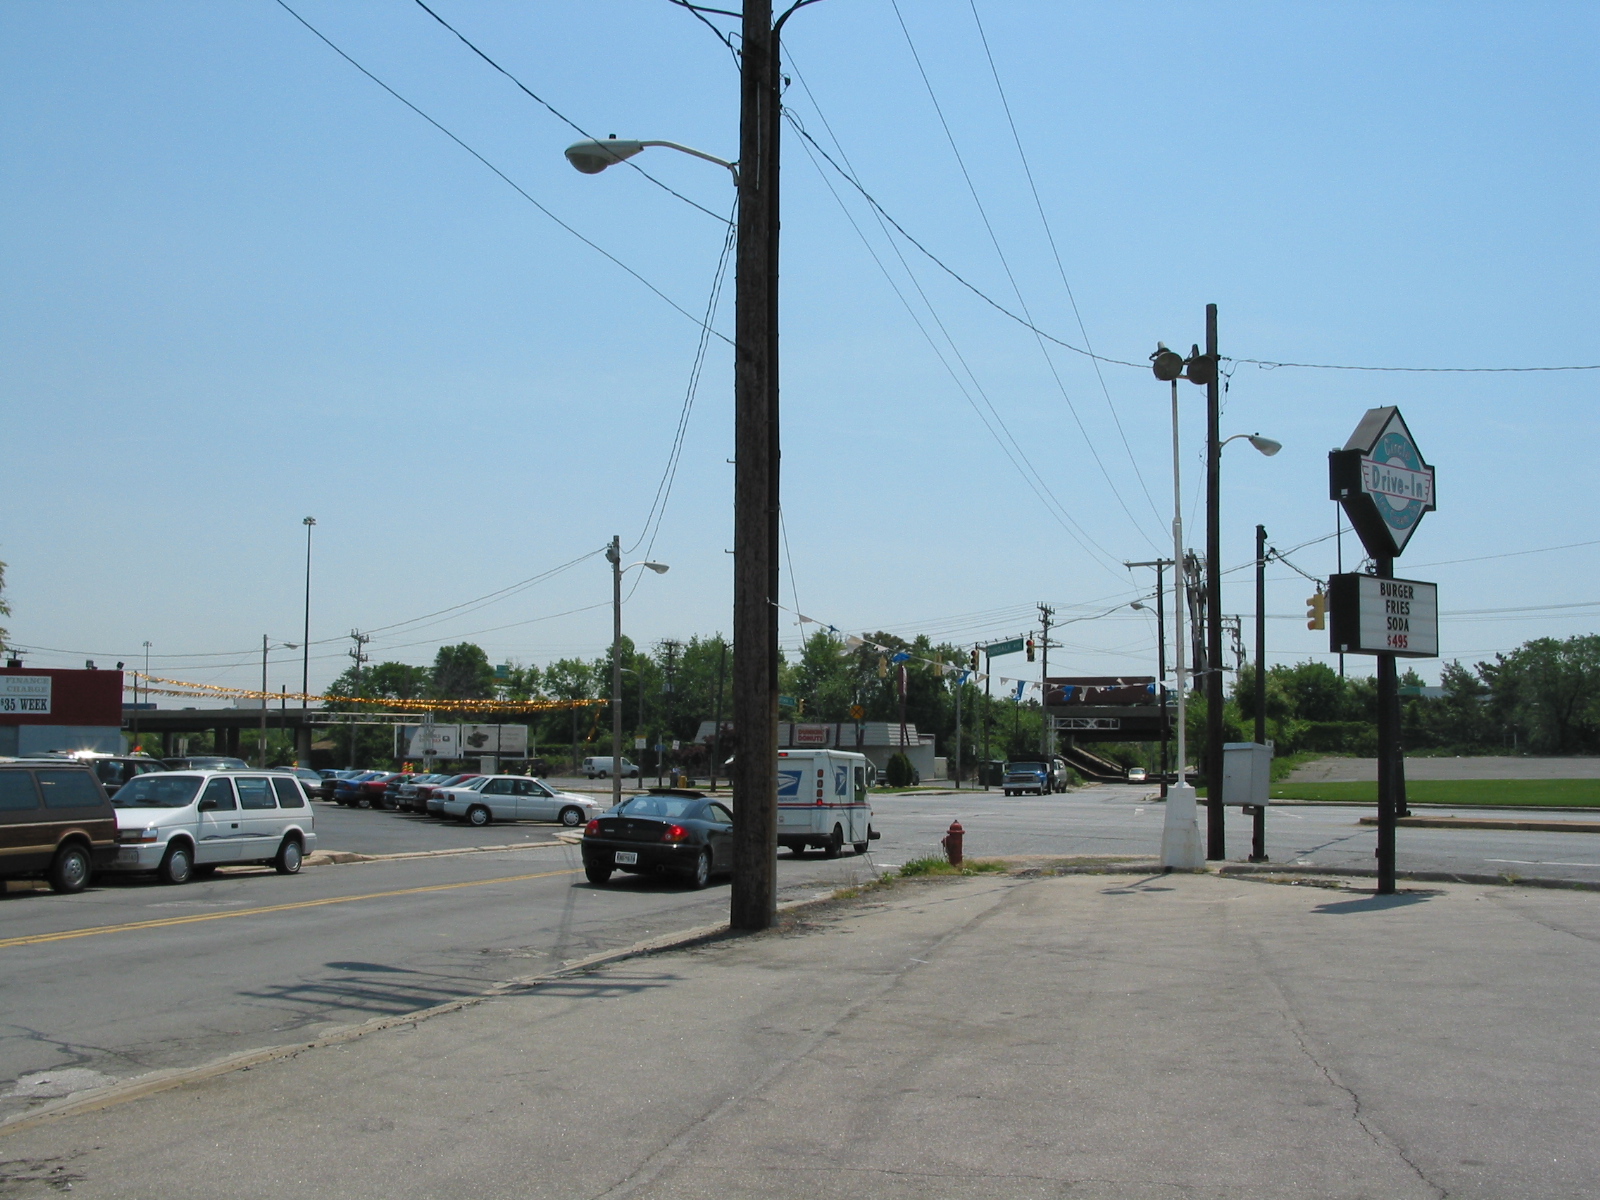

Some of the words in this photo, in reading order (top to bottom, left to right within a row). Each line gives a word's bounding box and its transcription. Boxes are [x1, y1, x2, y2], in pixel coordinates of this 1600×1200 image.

[1384, 438, 1412, 460] Circle
[1371, 465, 1423, 498] Drive-In
[1380, 582, 1414, 599] BURGER
[1385, 599, 1410, 615] FRIES
[1386, 616, 1410, 632] SODA
[1387, 634, 1408, 649] $495
[0, 698, 16, 711] $35
[20, 698, 47, 710] WEEK
